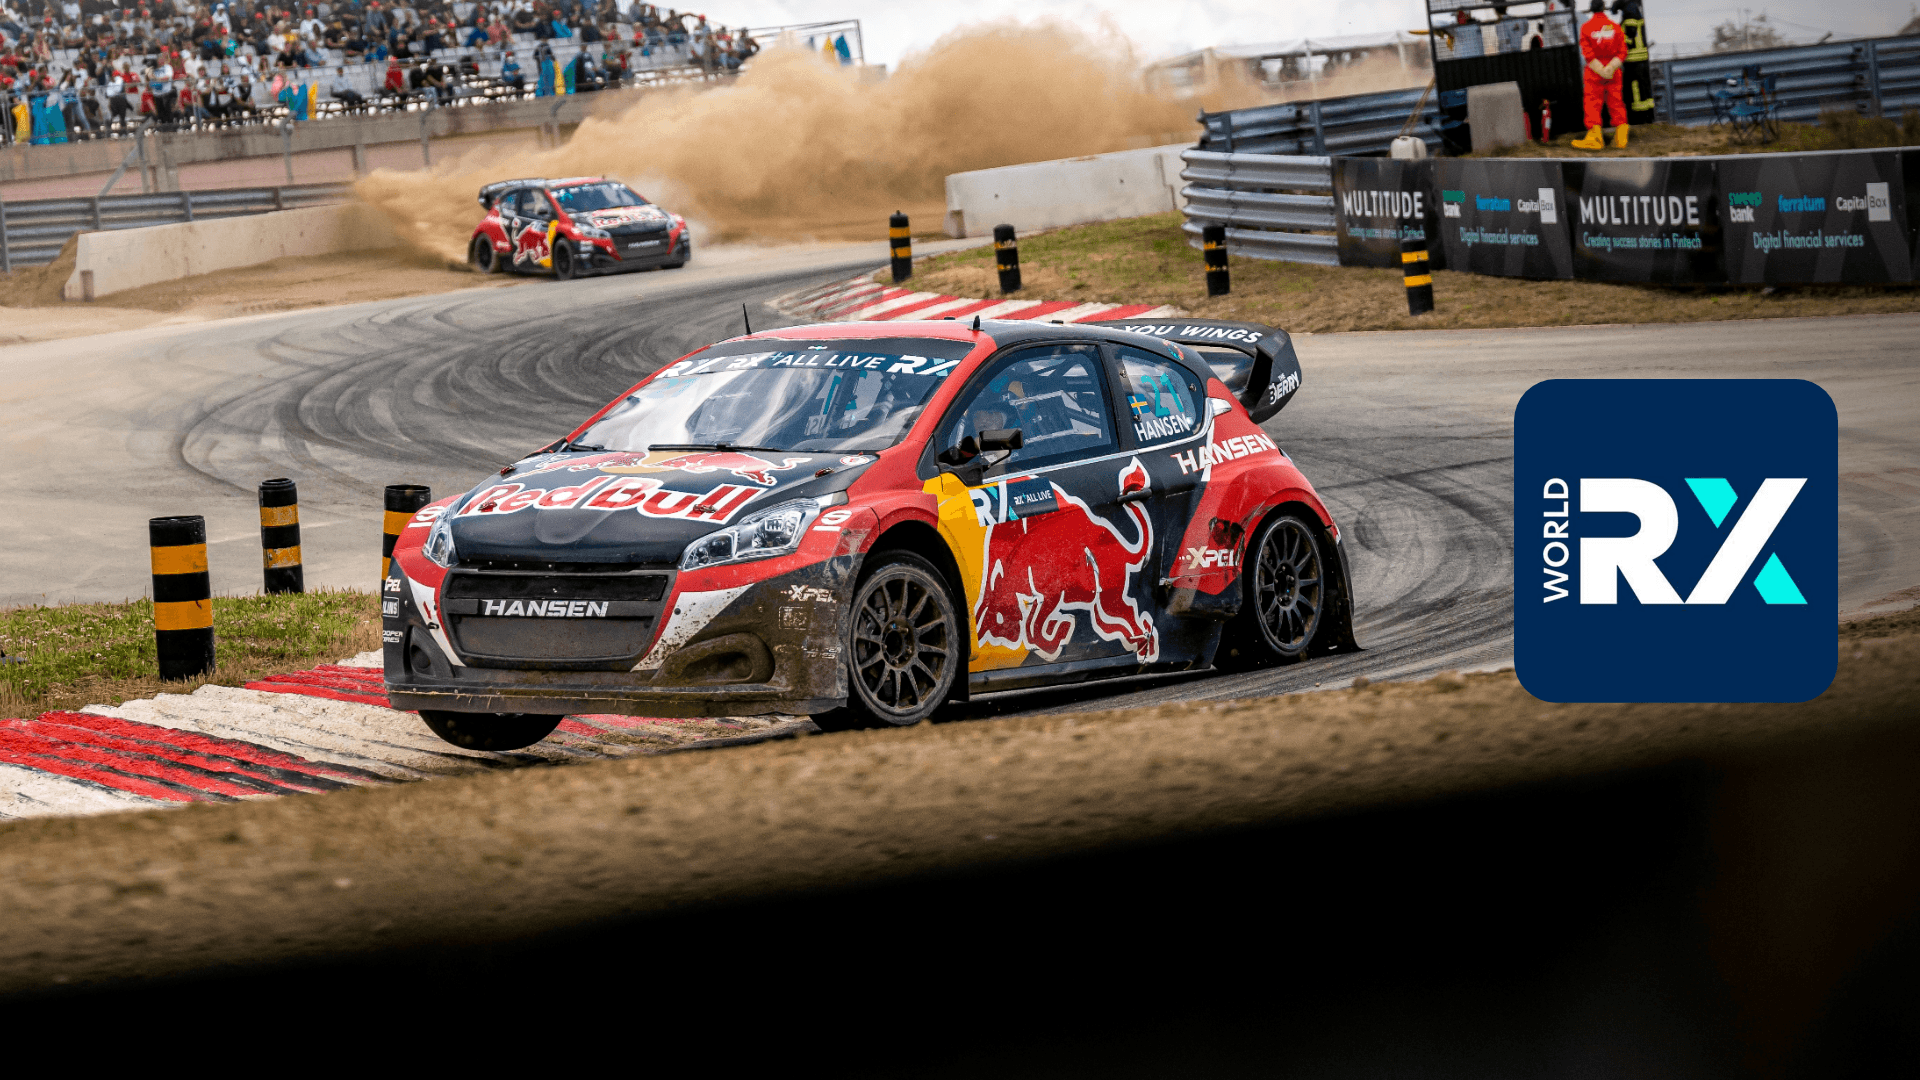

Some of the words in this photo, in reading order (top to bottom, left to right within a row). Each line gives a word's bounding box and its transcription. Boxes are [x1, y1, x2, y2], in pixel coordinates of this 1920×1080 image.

[1343, 190, 1424, 219] MULTITUDE
[1580, 196, 1699, 225] MULTITUDE
[1730, 206, 1754, 222] bank
[1778, 195, 1825, 212] ferratum
[1584, 231, 1611, 252] Creating
[1612, 237, 1637, 248] success
[1638, 233, 1661, 248] stories
[1672, 232, 1702, 248] Fintech
[1753, 230, 1781, 253] Digital
[1783, 229, 1822, 248] financial
[1825, 230, 1864, 247] services
[1125, 325, 1175, 336] YOU
[1179, 326, 1263, 343] WINGS
[825, 355, 886, 368] LIVE
[886, 355, 961, 377] RX
[1140, 373, 1184, 418] 21
[1269, 371, 1300, 405] BERRY
[1134, 414, 1191, 442] HANSEN
[1170, 433, 1279, 475] HANSEN
[452, 475, 613, 518] Red
[579, 476, 769, 525] Bull
[1038, 489, 1053, 501] LIVE
[482, 599, 609, 618] HANSEN
